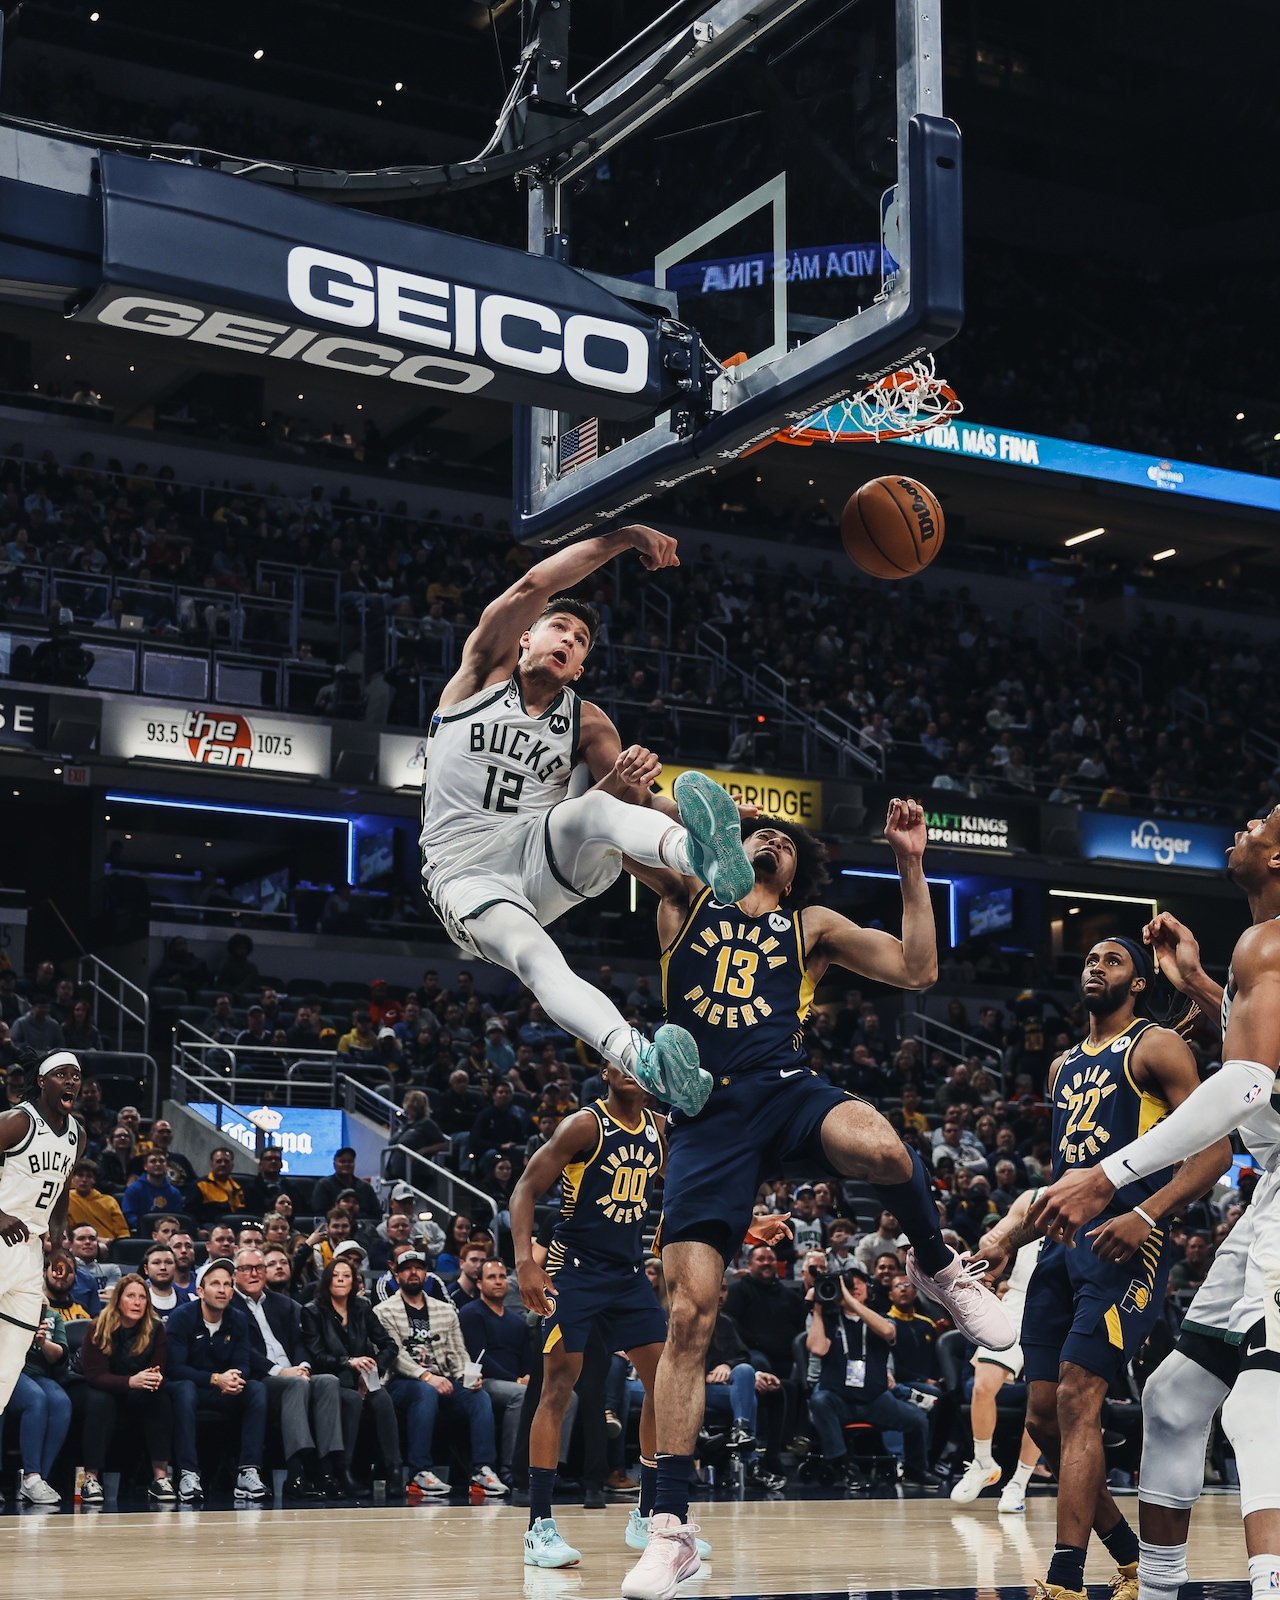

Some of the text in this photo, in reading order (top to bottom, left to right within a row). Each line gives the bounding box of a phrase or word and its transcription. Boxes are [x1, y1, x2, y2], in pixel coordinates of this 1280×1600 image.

[288, 246, 648, 393] GEICO
[97, 296, 495, 393] GEICO
[962, 427, 997, 457] MÁS
[999, 434, 1040, 466] FINA
[146, 722, 179, 744] 93.5
[183, 711, 238, 742] the
[257, 734, 293, 756] 107.5
[194, 736, 254, 768] fan
[469, 722, 563, 784] BUCKS
[482, 765, 525, 813] 12
[924, 811, 1009, 834] RAFTKINGS
[927, 827, 1008, 848] SPORTSBOOK
[1130, 820, 1191, 865] Kroger
[690, 920, 788, 970] INDIANA
[712, 945, 759, 999] 13
[683, 984, 773, 1029] PACERS
[1057, 1065, 1118, 1110] INDIANA
[1066, 1087, 1101, 1137] 22
[600, 1143, 658, 1178] INDIANA
[35, 1180, 61, 1210] 21
[611, 1166, 648, 1202] 00
[595, 1194, 649, 1224] PACERS
